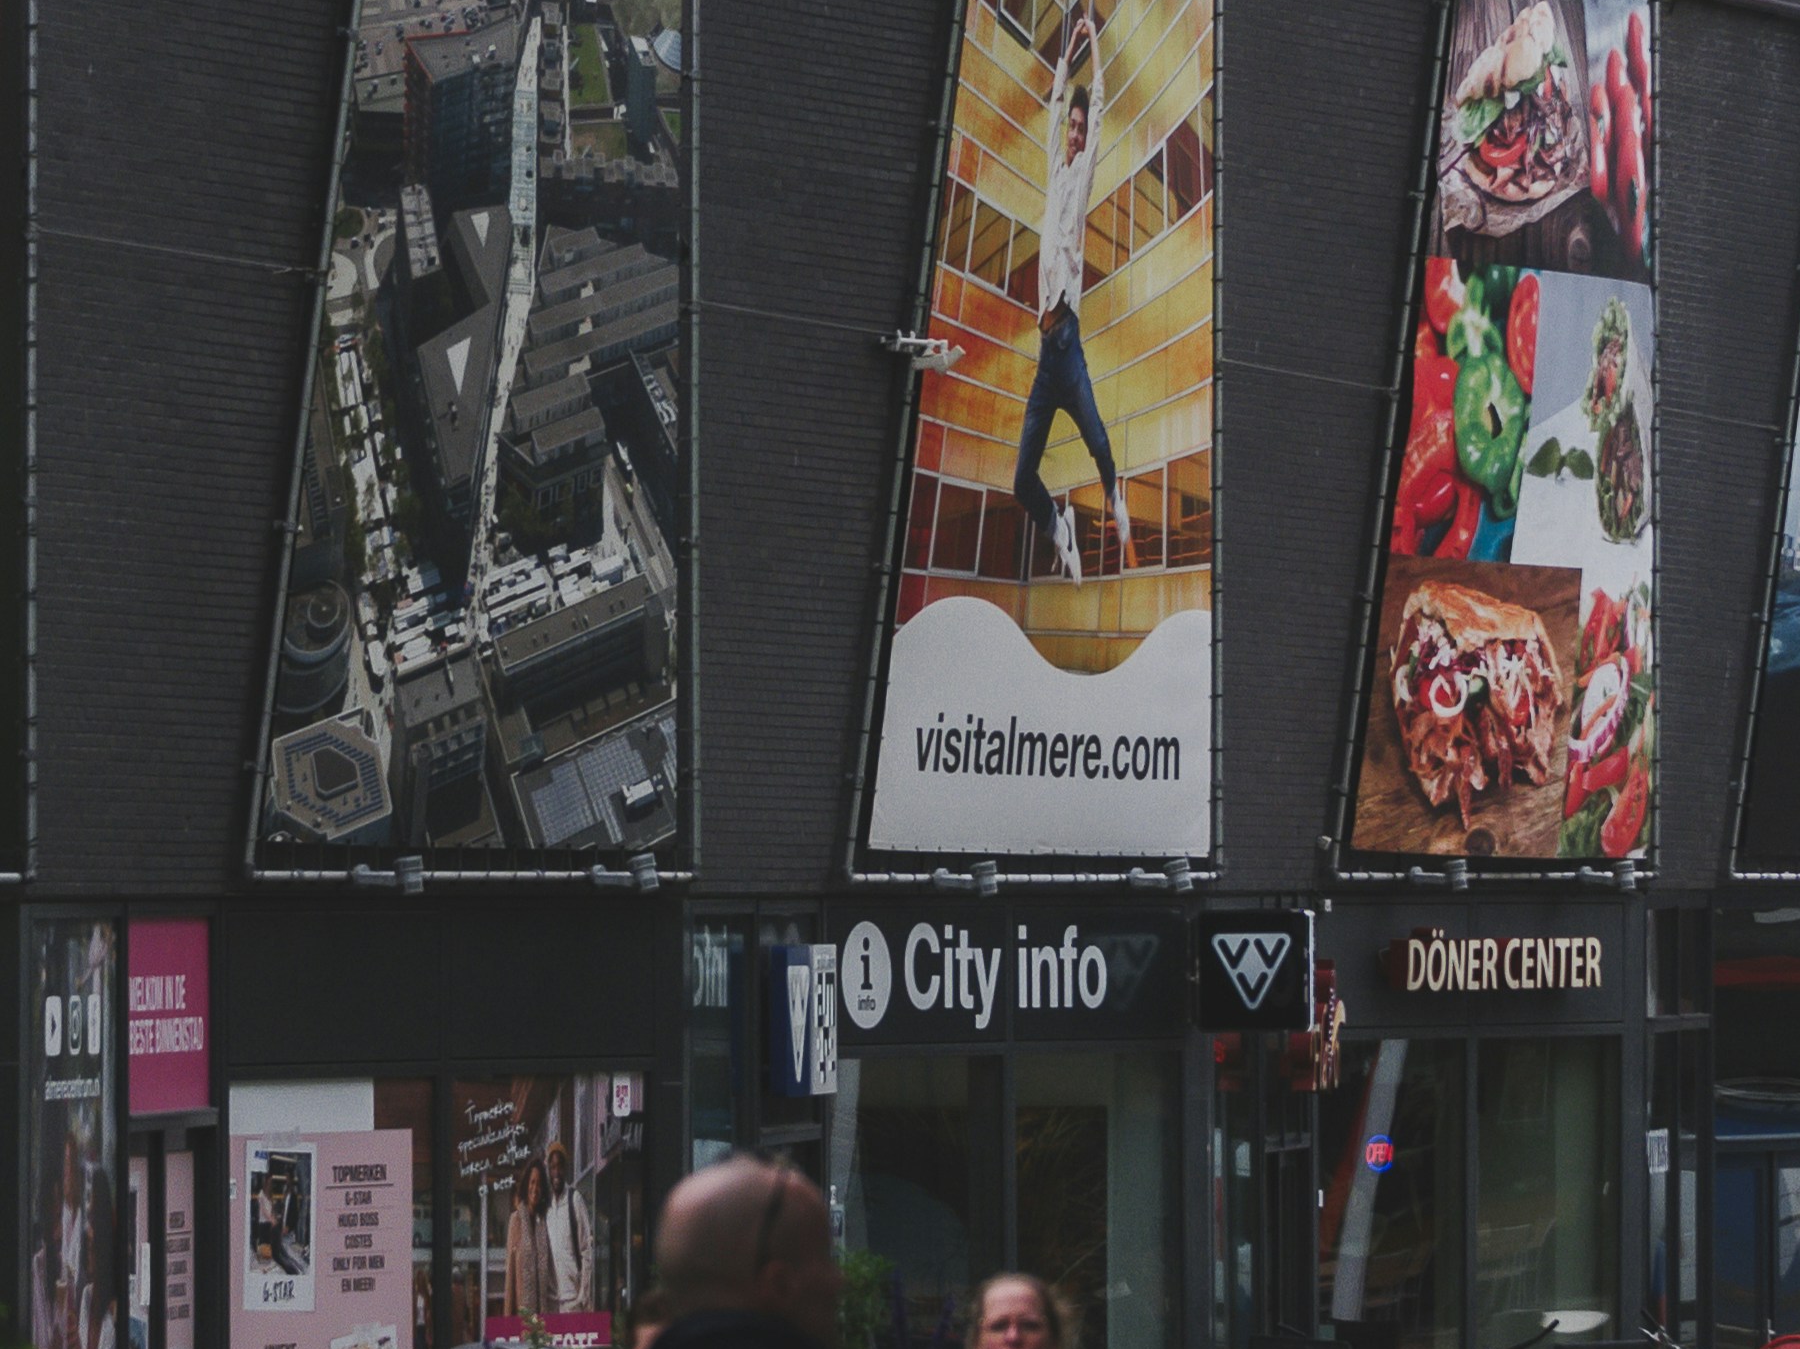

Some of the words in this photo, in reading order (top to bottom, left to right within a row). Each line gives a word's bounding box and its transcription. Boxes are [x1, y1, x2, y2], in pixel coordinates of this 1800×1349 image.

[916, 712, 1180, 781] visitalmere.com
[1406, 929, 1498, 992] DÖNER
[1503, 936, 1602, 989] CENTER
[904, 922, 1001, 1030] City
[1018, 924, 1108, 1009] info
[857, 996, 876, 1011] info
[332, 1164, 387, 1183] TOPMERKEN
[345, 1191, 372, 1205] G-STAR
[338, 1213, 358, 1228] HUGO
[360, 1212, 379, 1226] BOSS
[353, 1256, 367, 1269] FOR
